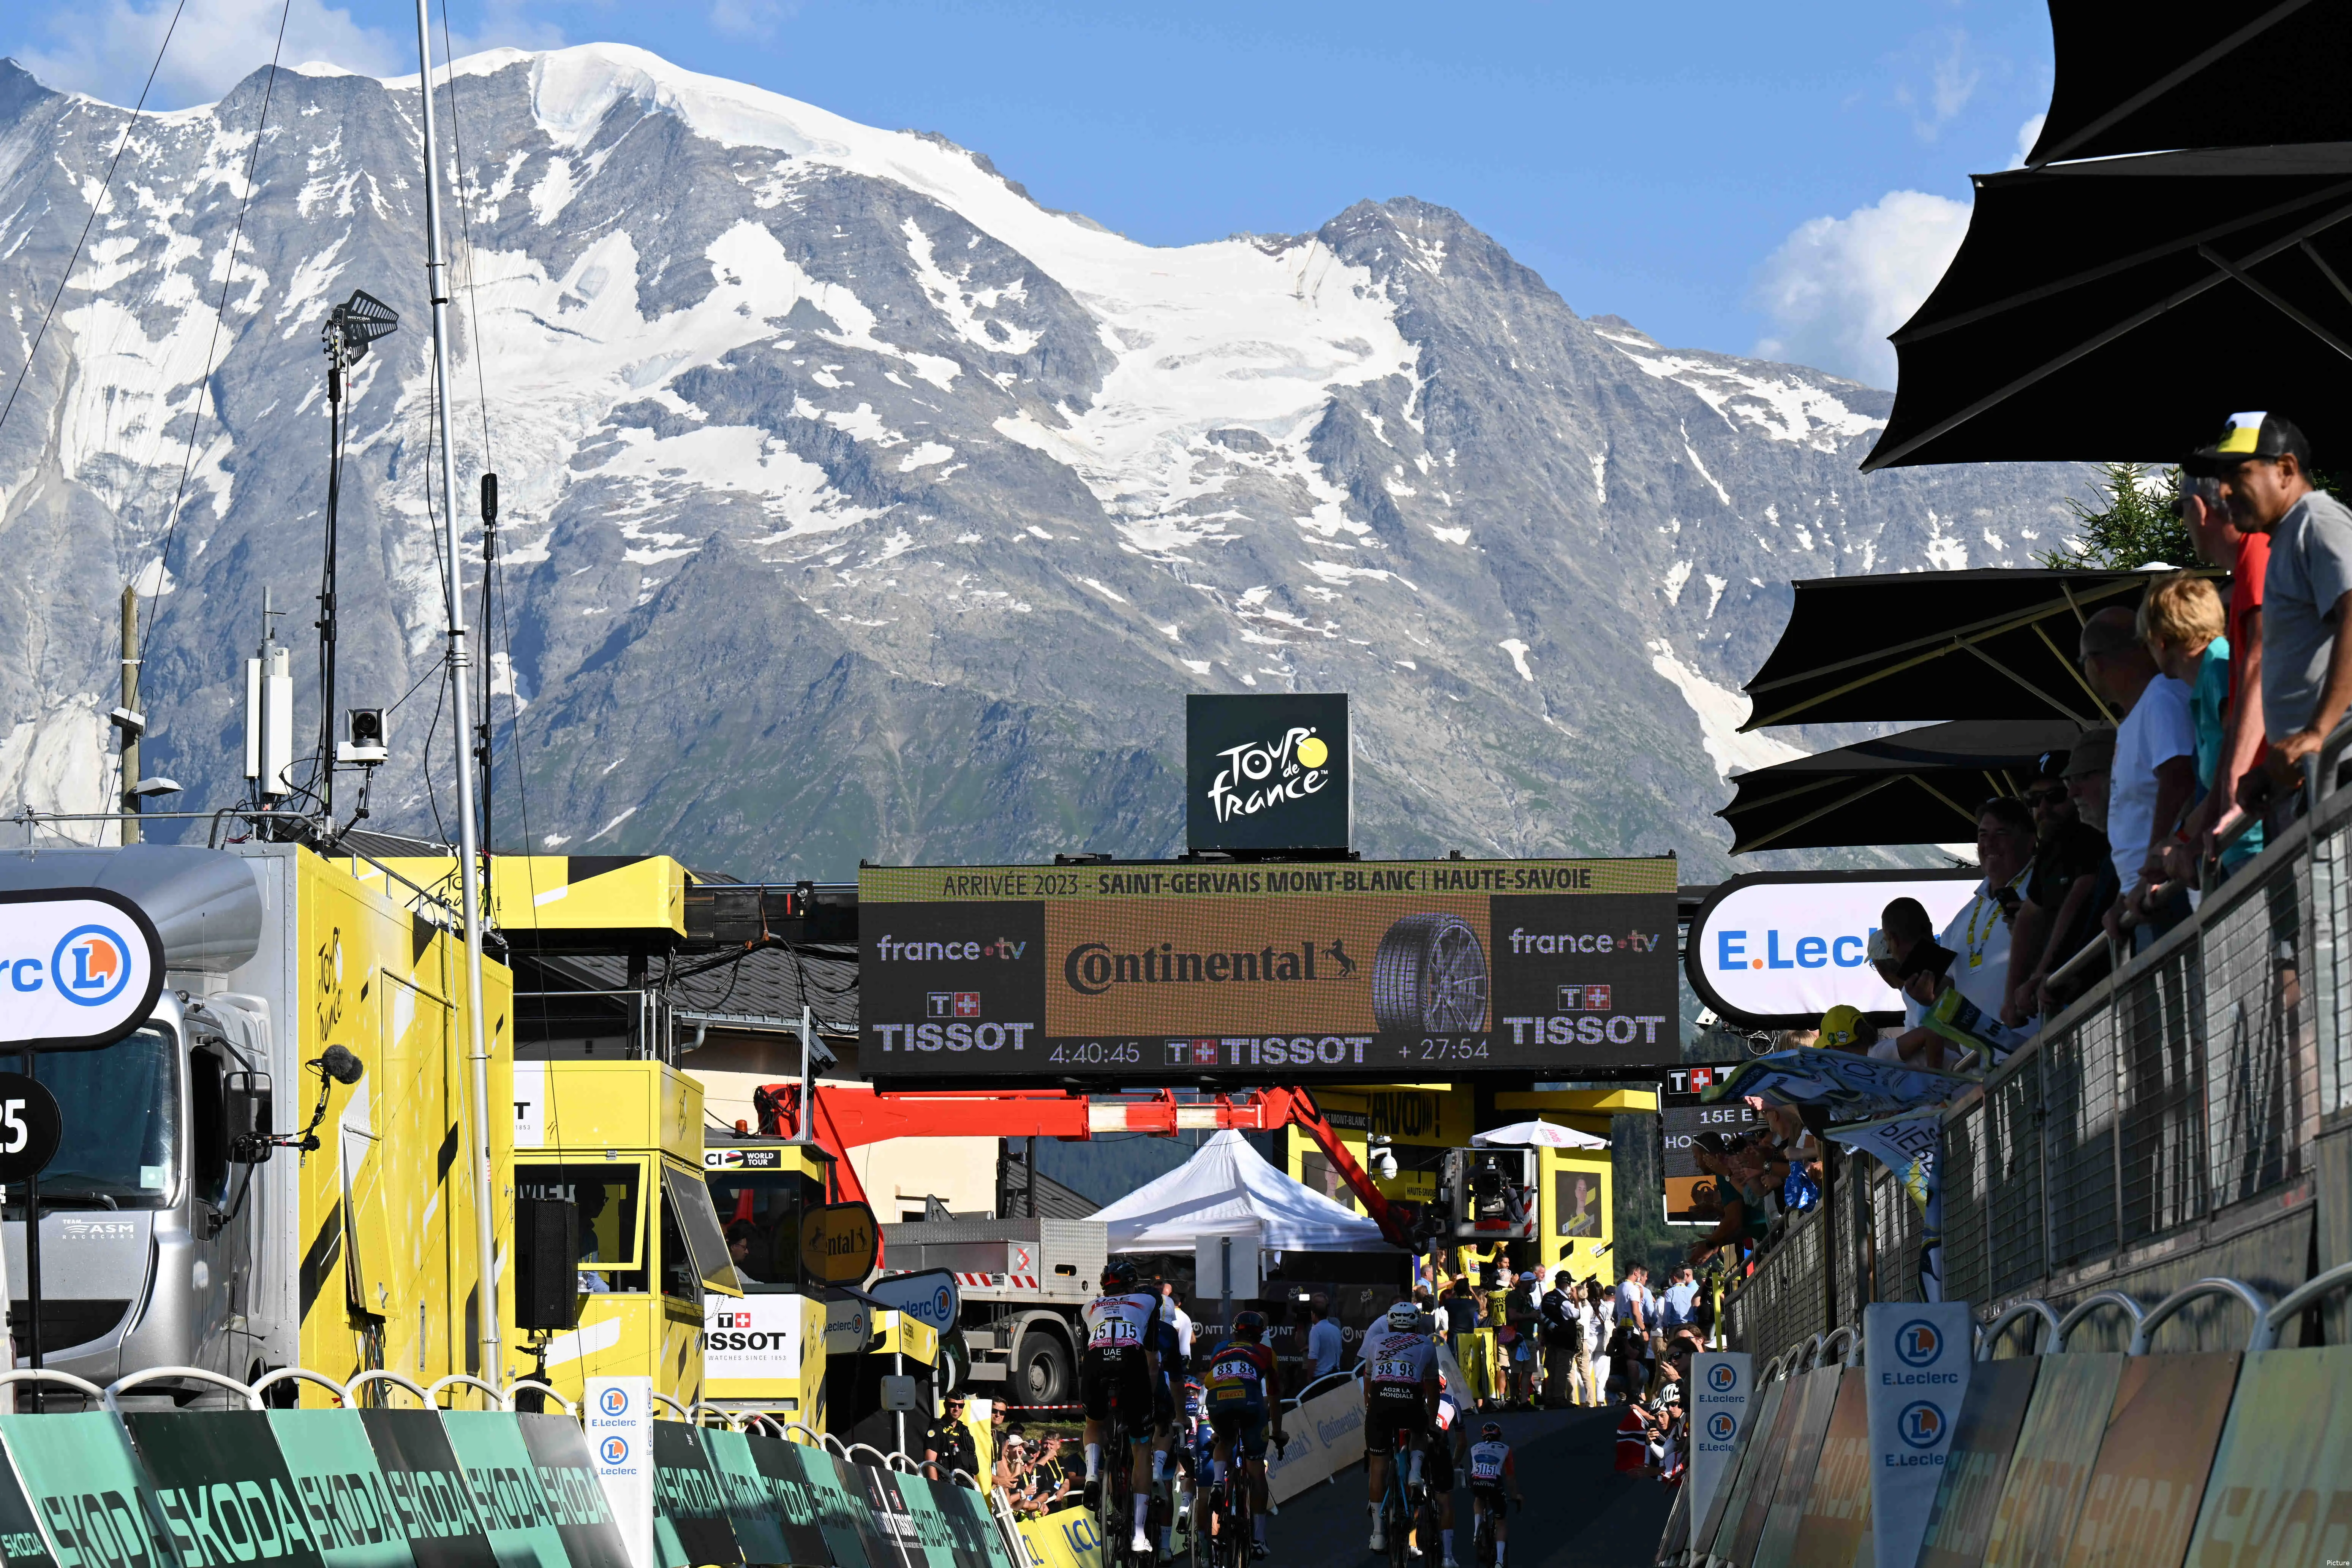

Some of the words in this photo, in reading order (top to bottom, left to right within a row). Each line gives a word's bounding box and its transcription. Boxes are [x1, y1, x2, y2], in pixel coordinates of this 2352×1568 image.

[1283, 760, 1299, 778] de
[943, 871, 1027, 896] ARRIVÉE
[1034, 874, 1078, 895] 2023
[1099, 871, 1260, 894] SAINT-GERVAIS
[1266, 869, 1416, 893] MONT-BLANC
[1433, 868, 1592, 890] HAUTE-SAVOIE
[1064, 941, 1318, 995] Continental
[873, 1022, 1034, 1051] TISSOT
[1503, 1015, 1666, 1044] TISSOT
[1049, 1042, 1140, 1063] 4:40:45
[1221, 1037, 1372, 1065] TISSOT
[1421, 1038, 1489, 1059] 27:54
[1331, 1114, 1366, 1127] MONT-BLANC
[1700, 1109, 1735, 1124] 15E
[1407, 1187, 1436, 1198] HAUTE-SAVOIE
[1495, 1304, 1505, 1312] 12
[1093, 1323, 1106, 1341] 15
[1122, 1324, 1137, 1339] 15
[1206, 1325, 1223, 1335] NTT
[1380, 1335, 1404, 1345] AG2R
[1375, 1350, 1388, 1361] LA
[1382, 1337, 1424, 1361] MONDIALE
[1217, 1363, 1233, 1376] 88
[1239, 1362, 1254, 1376] 88
[1378, 1362, 1392, 1375] 98
[1400, 1363, 1414, 1377] 98
[1882, 1371, 1958, 1386] E.Leclerc
[1699, 1394, 1745, 1402] E.Leclerc
[1062, 1518, 1101, 1553] LCL
[1, 1533, 46, 1558] SKODA
